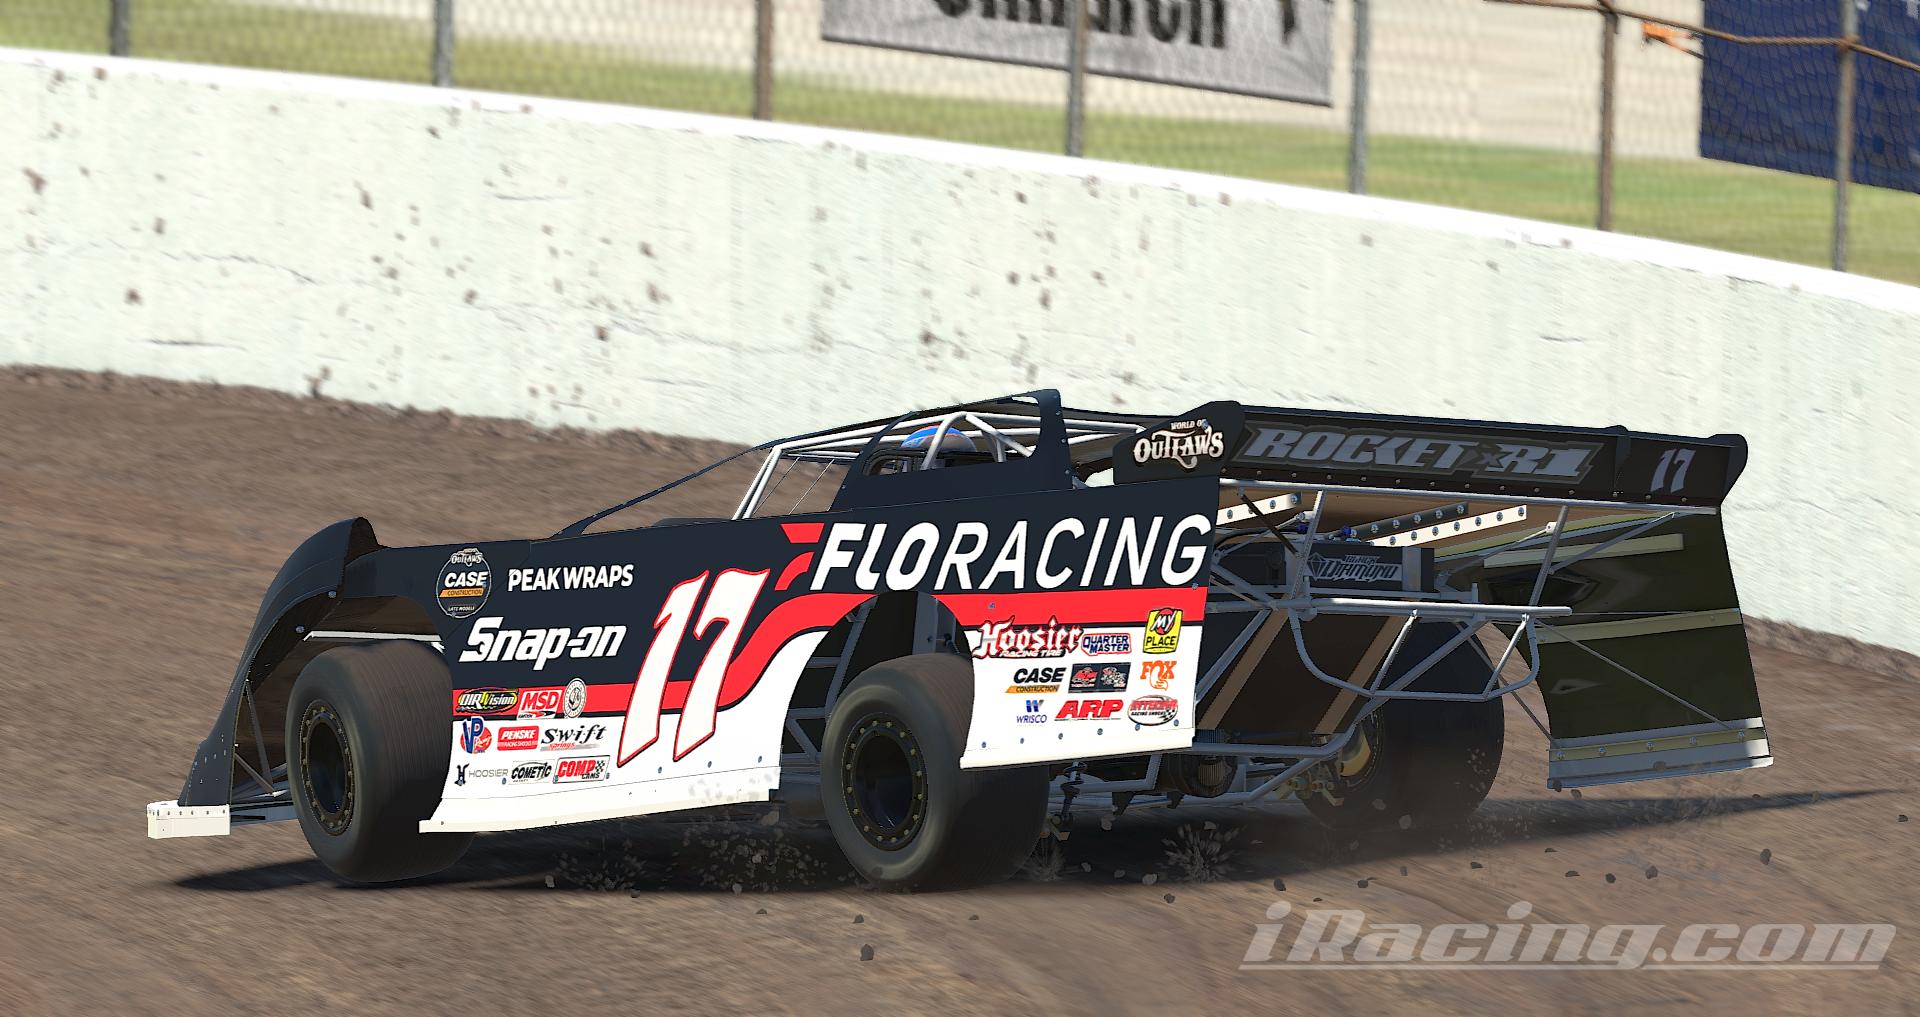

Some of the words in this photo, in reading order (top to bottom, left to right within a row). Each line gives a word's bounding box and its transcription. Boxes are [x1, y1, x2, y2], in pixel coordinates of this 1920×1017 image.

[1170, 420, 1195, 430] WORLD
[1133, 425, 1224, 469] OUTLAWS
[1245, 428, 1479, 469] ROCKET
[1650, 448, 1696, 494] 17
[444, 571, 489, 588] CASE
[508, 567, 560, 591] PEAK
[563, 564, 634, 589] WRAPS
[447, 589, 482, 597] CONSTRUCTION
[1151, 610, 1178, 632] MY
[458, 616, 627, 671] Snap-on
[972, 615, 1083, 659] Hoosier
[1083, 635, 1129, 648] QUARTER
[1146, 636, 1177, 646] PLACE
[1040, 649, 1064, 657] TIRE
[1090, 643, 1130, 653] MASTER
[618, 568, 770, 767] 17
[1013, 667, 1067, 683] CASE
[1140, 660, 1177, 690] FOX
[1016, 685, 1058, 693] CONSTRUCTION
[521, 691, 560, 711] MSD
[1056, 699, 1124, 718] ARP
[1016, 714, 1048, 724] WRISCO
[462, 717, 484, 754] VP
[501, 730, 537, 740] PENSKE
[468, 769, 509, 778] HOOSIER
[511, 764, 552, 780] COMETIC
[557, 760, 596, 777] COMP
